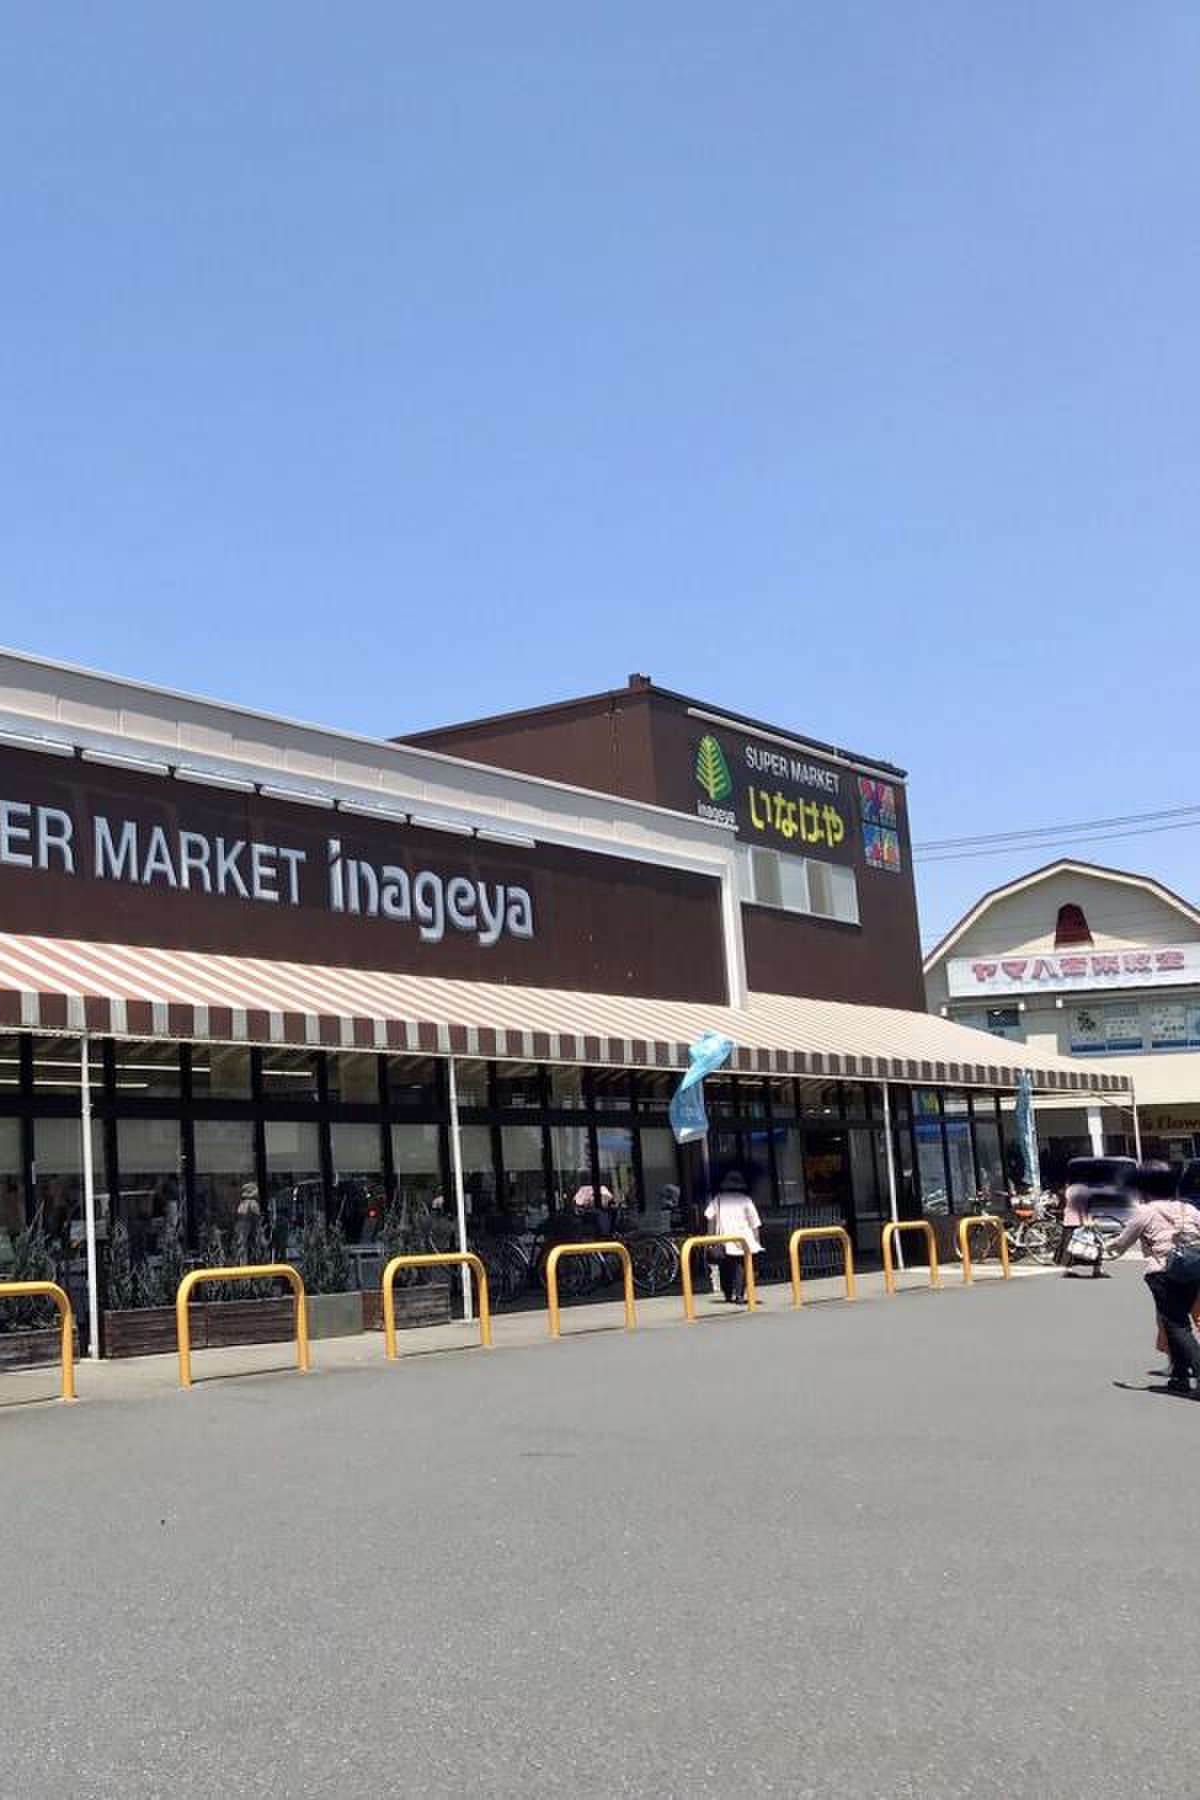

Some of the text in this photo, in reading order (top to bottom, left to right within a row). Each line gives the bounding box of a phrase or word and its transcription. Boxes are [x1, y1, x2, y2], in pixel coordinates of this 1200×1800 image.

[746, 745, 840, 794] SUPER MARKET
[93, 816, 307, 905] MARKET
[328, 839, 535, 946] inageya
